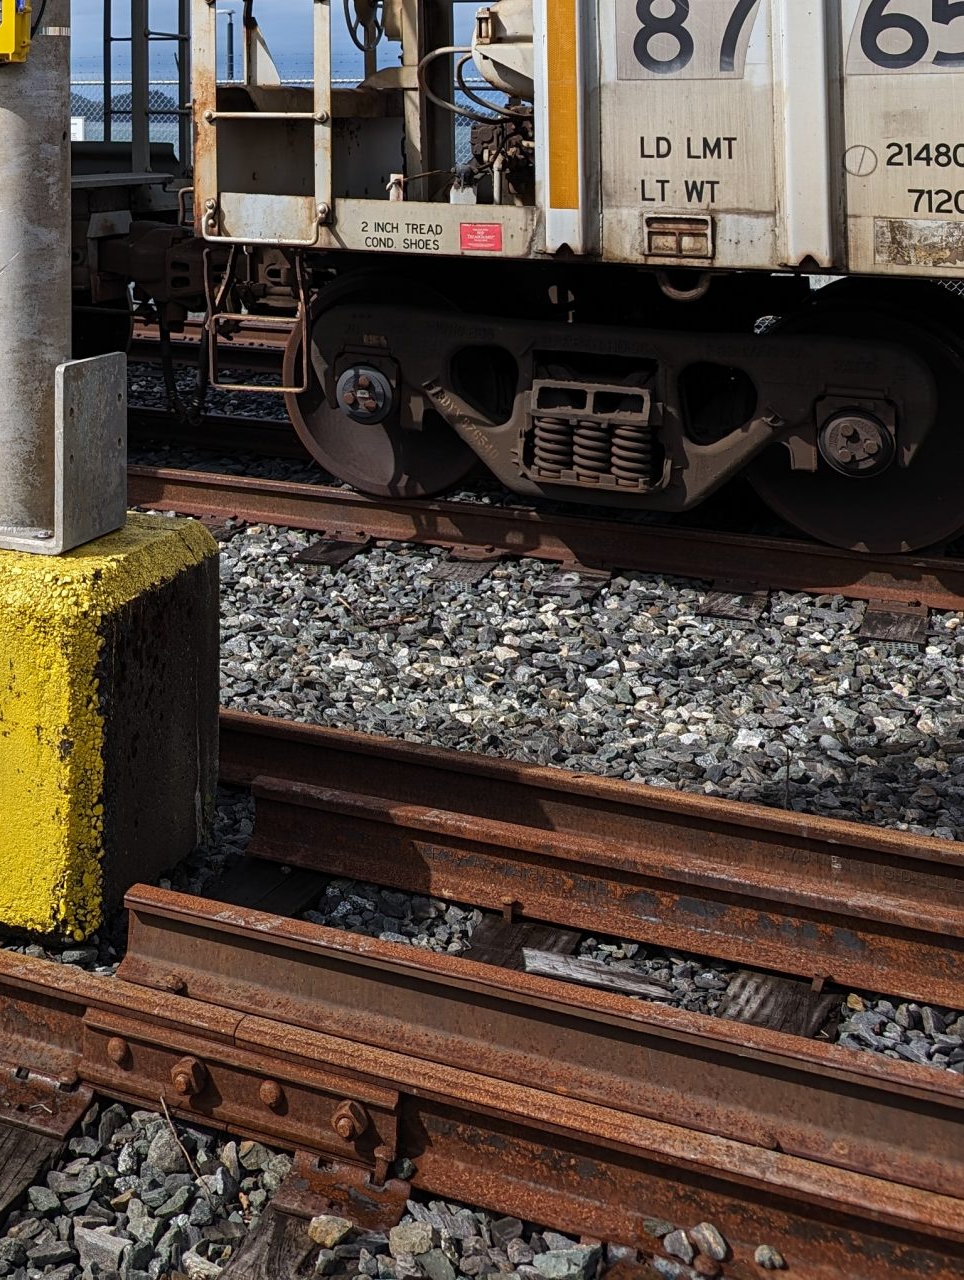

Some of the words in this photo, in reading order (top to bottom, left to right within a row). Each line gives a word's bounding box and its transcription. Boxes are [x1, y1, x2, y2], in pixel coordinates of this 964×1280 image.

[640, 136, 672, 159] LD
[687, 136, 737, 160] LMT
[641, 179, 670, 202] LT
[684, 180, 720, 203] WT
[361, 221, 369, 233] 2
[374, 222, 399, 234] INCH
[405, 223, 443, 236] TREAD
[364, 236, 397, 249] COND.
[402, 238, 440, 251] SHOES
